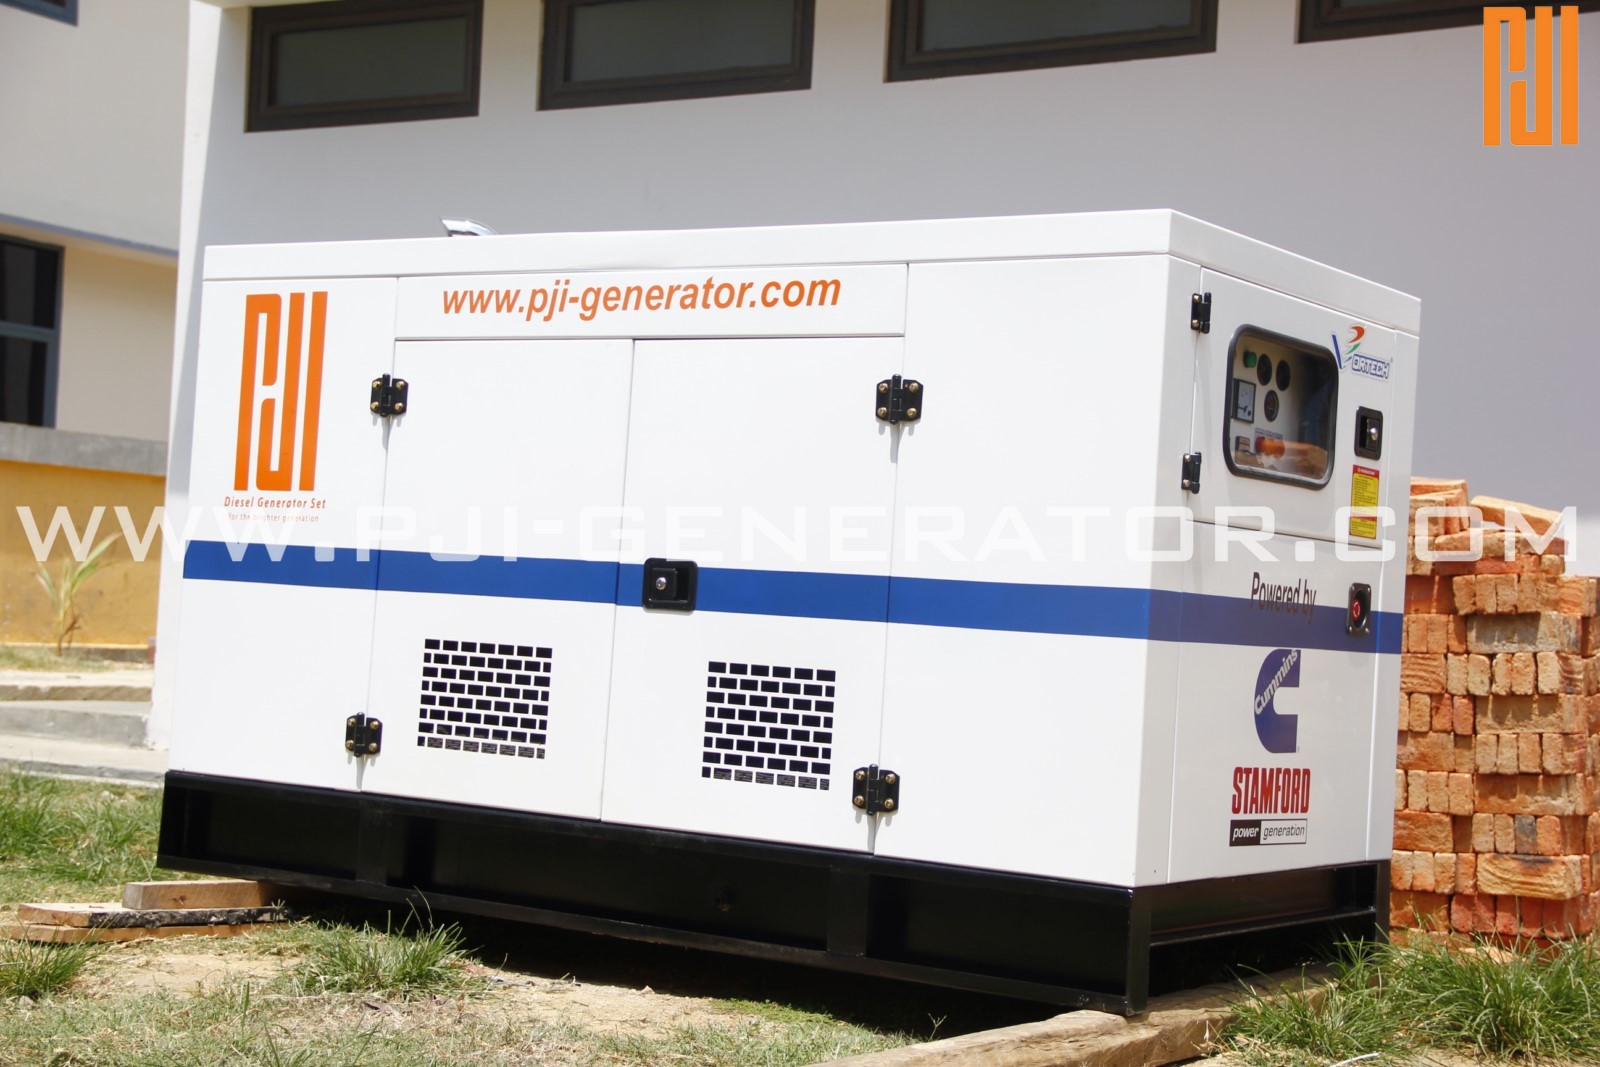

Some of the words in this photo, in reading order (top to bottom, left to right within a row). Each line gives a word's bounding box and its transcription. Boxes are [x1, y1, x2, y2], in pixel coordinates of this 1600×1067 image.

[442, 275, 842, 322] www.pji-generator.com
[224, 496, 255, 508] Diesel
[257, 497, 308, 509] Generator
[310, 498, 326, 509] Set
[1250, 571, 1302, 614] Powered
[1302, 578, 1317, 625] by
[1254, 647, 1298, 715] Cummins
[1231, 766, 1311, 815] STAMFORD
[1232, 827, 1260, 841] power
[1262, 824, 1305, 841] generation
